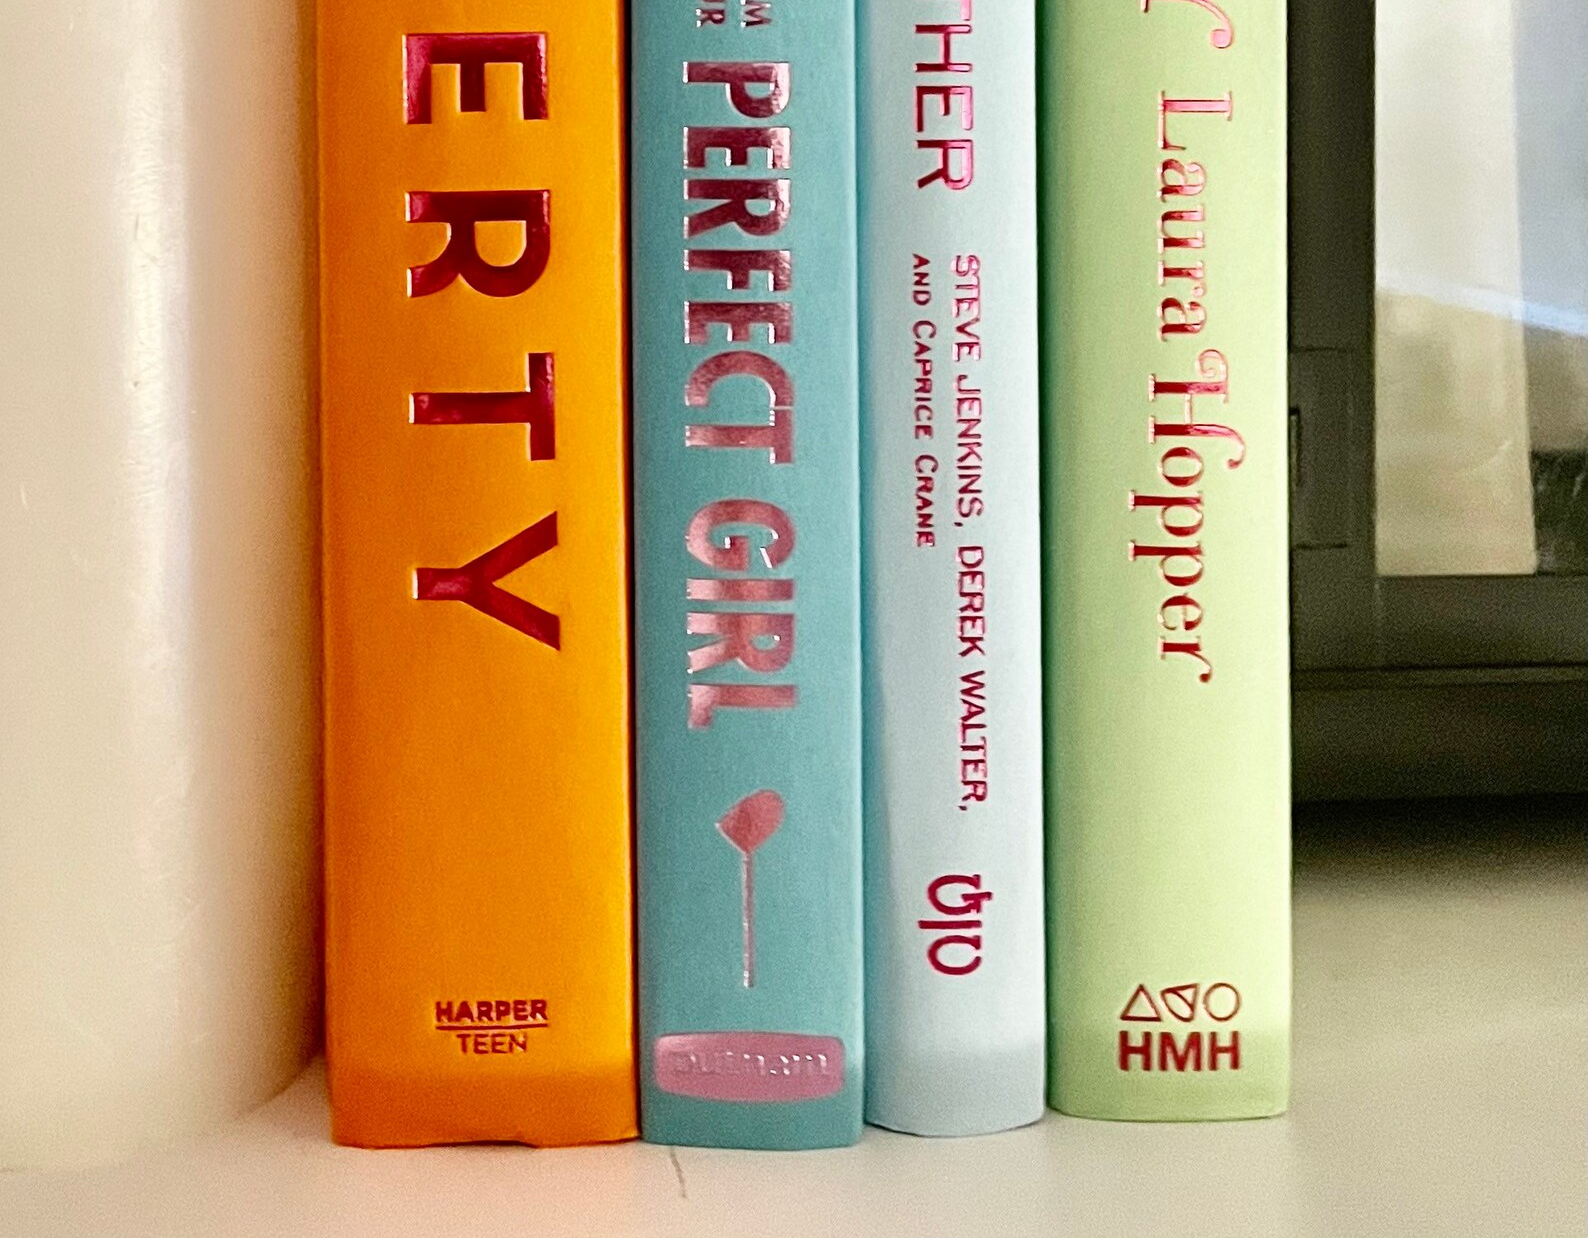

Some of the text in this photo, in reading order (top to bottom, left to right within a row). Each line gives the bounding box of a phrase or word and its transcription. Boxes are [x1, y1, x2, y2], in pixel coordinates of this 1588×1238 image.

[683, 61, 797, 730] PERFECT GIRL
[911, 254, 939, 548] AND CAPRICE CRANE
[952, 254, 988, 811] STEVE JENKINS, DEREK WALTER,
[1128, 89, 1246, 684] Laura Hopper
[435, 999, 548, 1022] HARPER
[456, 1033, 528, 1055] TEEN
[1118, 1031, 1241, 1072] HMH
